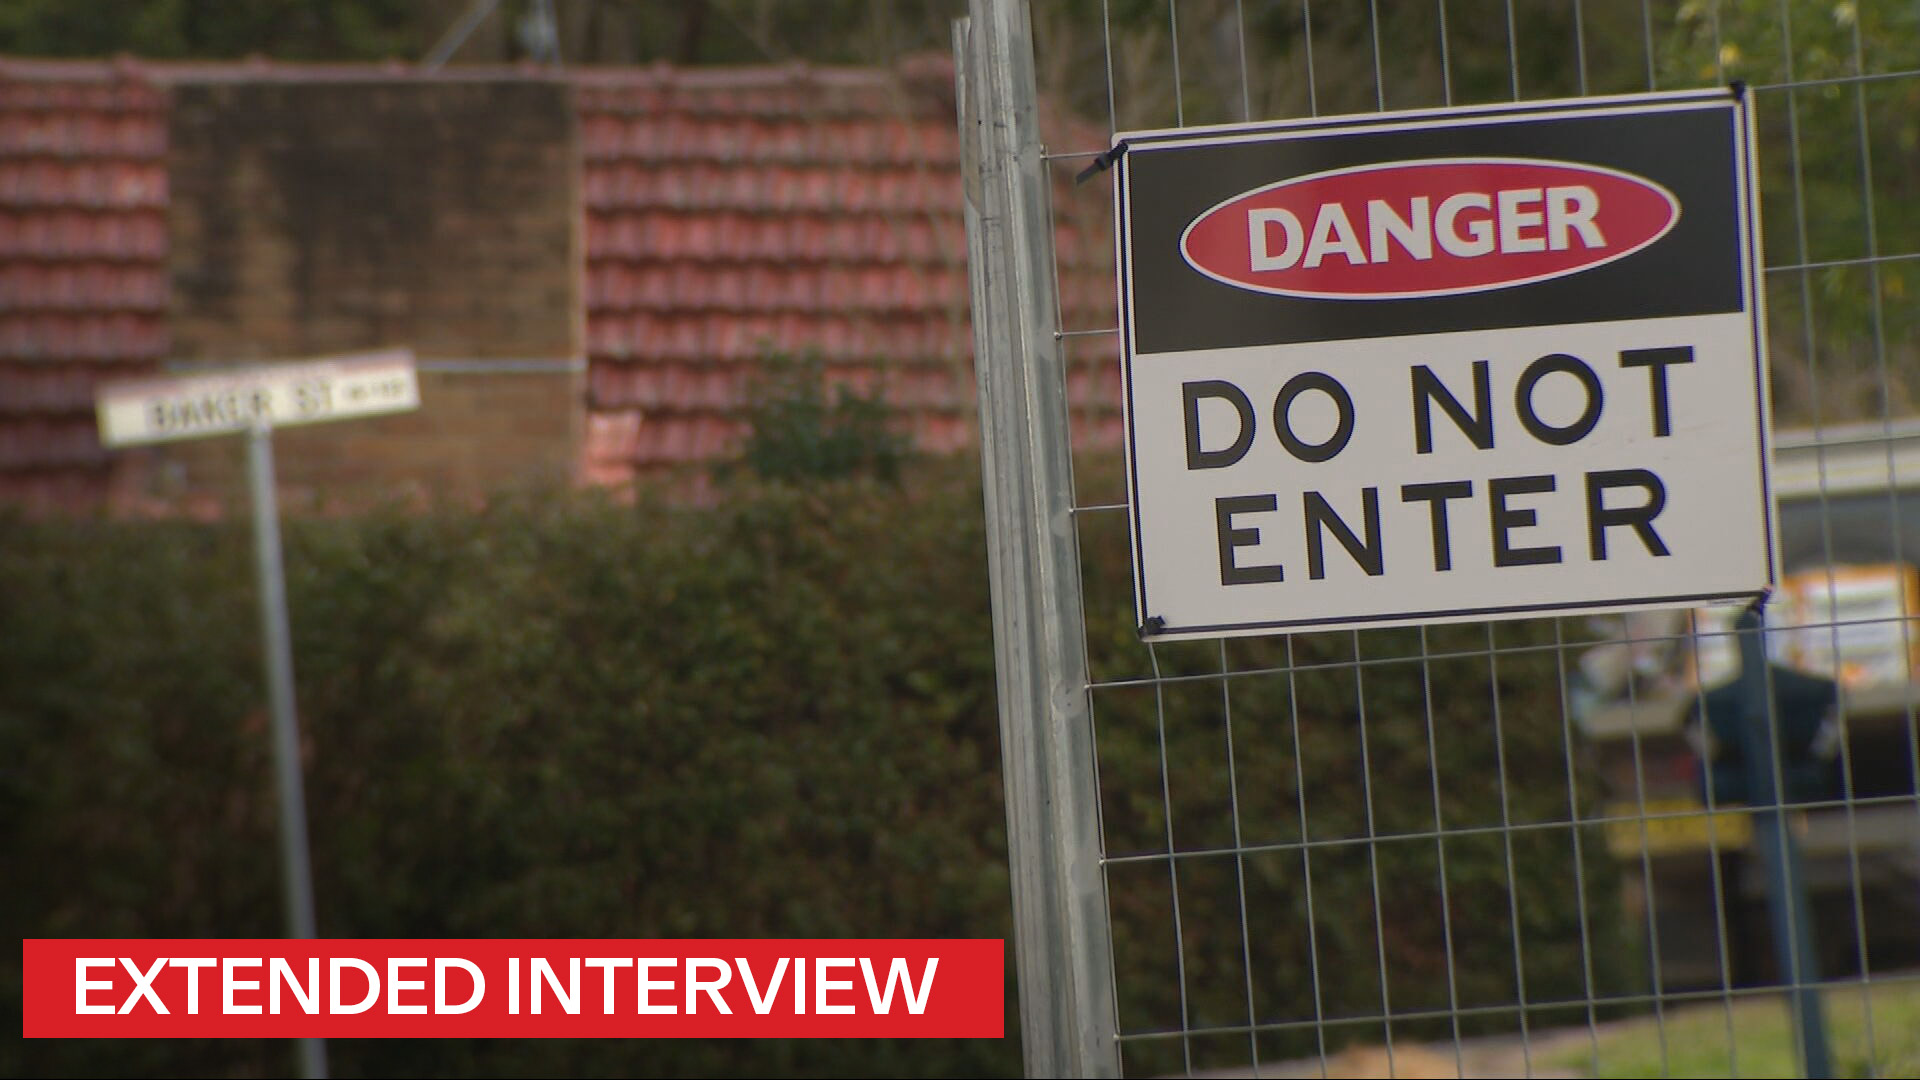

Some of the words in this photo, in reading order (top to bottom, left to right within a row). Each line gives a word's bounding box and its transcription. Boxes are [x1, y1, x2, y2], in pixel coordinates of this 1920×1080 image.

[1247, 184, 1607, 273] DANGER
[144, 386, 273, 432] BAKER
[294, 378, 333, 415] ST
[1182, 371, 1355, 471] DO
[1411, 345, 1695, 455] NOT
[1215, 468, 1671, 587] ENTER
